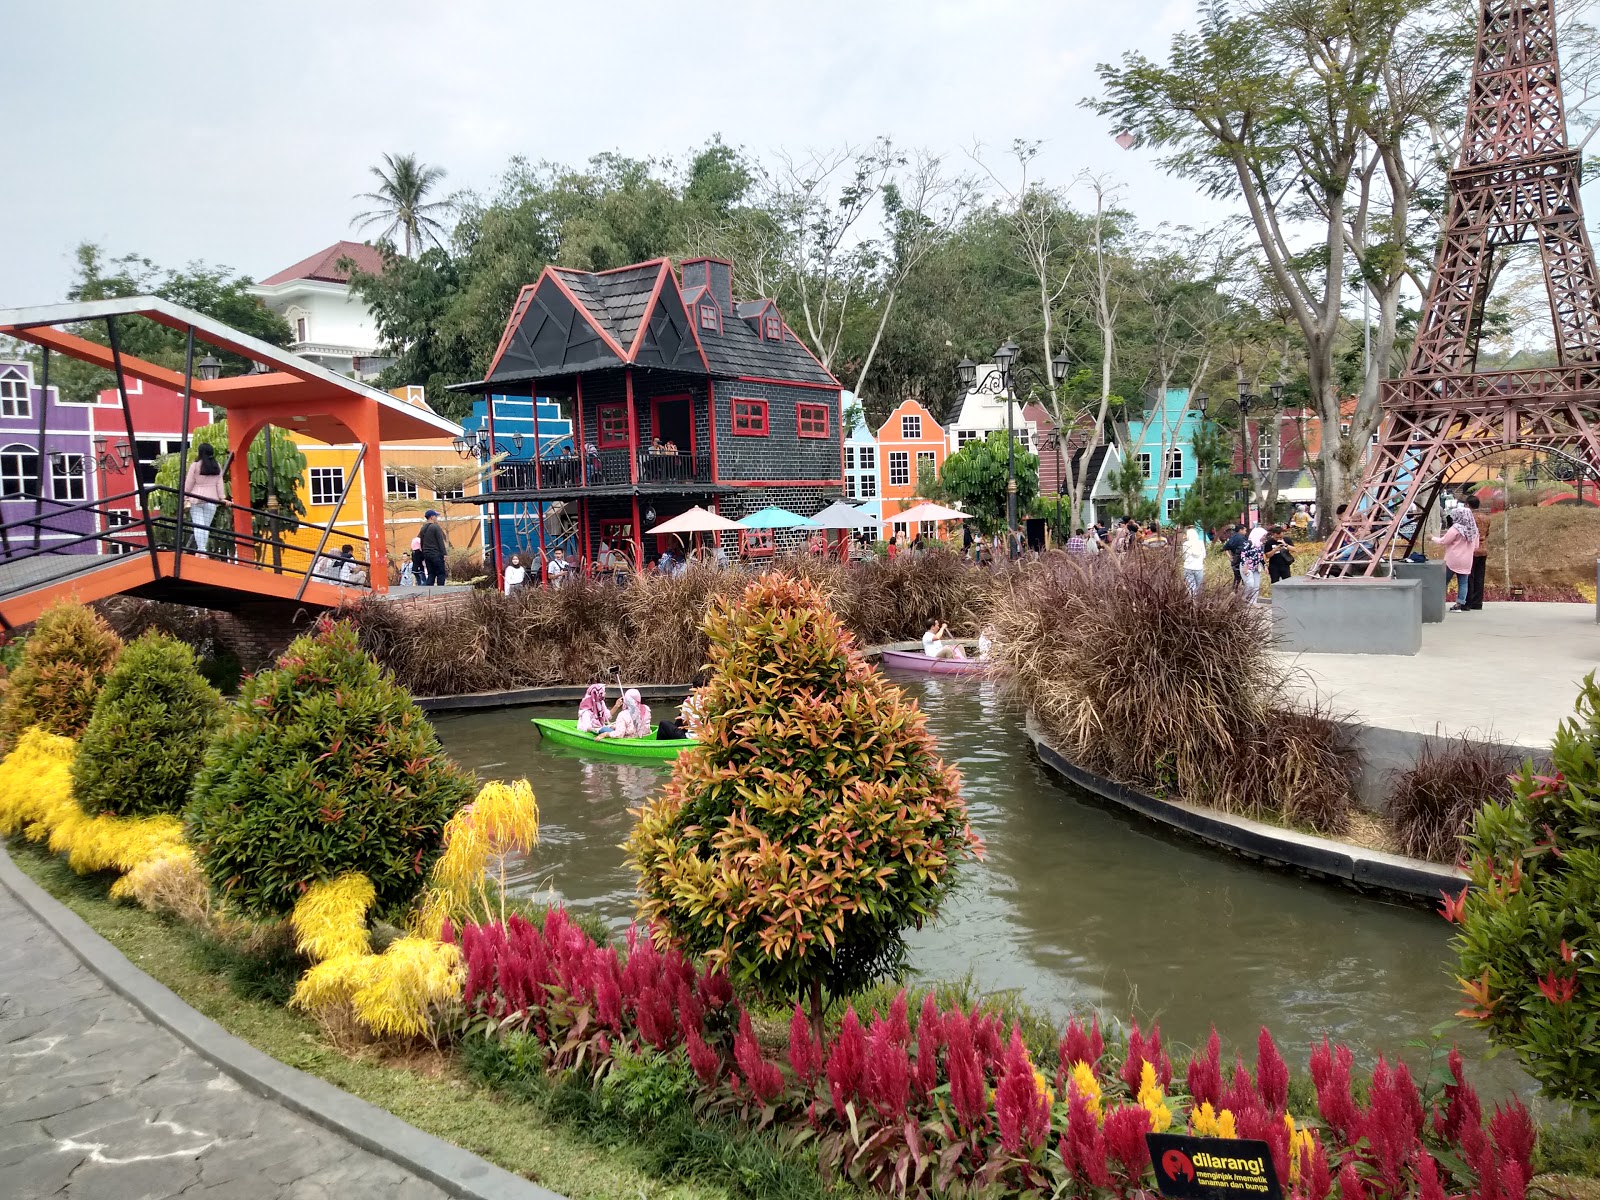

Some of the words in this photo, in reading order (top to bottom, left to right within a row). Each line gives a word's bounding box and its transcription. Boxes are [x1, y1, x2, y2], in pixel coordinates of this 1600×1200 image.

[1192, 1152, 1265, 1175] dilarang!
[1196, 1171, 1233, 1181] menginjak
[1198, 1178, 1229, 1187] tanaman
[1230, 1181, 1244, 1189] dan
[1245, 1183, 1269, 1192] bunga
